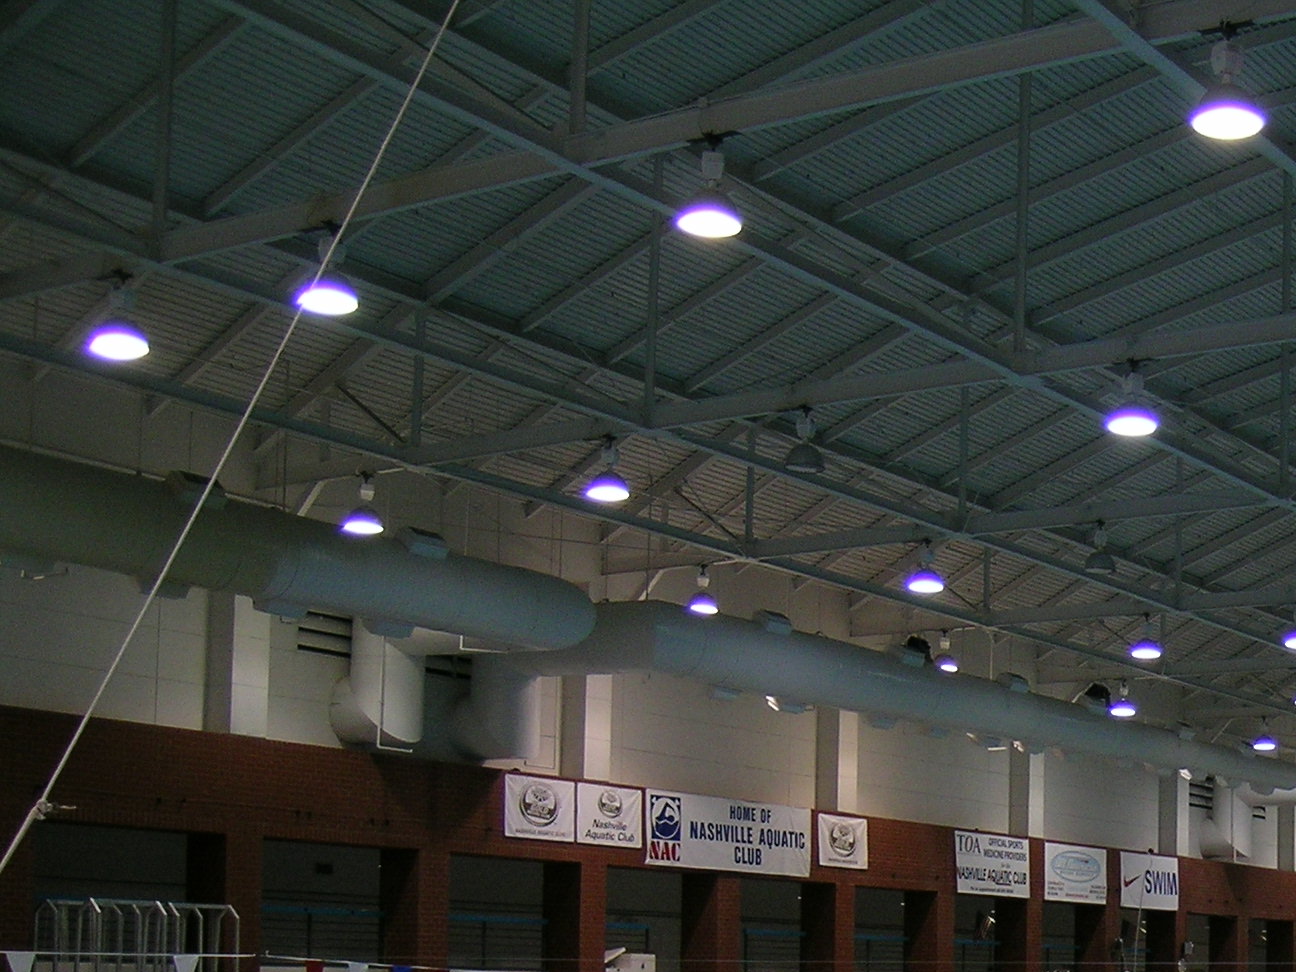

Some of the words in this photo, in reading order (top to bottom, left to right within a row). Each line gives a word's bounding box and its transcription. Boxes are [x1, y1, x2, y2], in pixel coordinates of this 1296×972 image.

[729, 804, 757, 823] HOME
[760, 806, 772, 823] OF
[592, 818, 628, 832] Nashville
[585, 828, 615, 842] Aquatic
[617, 832, 635, 844] Club
[689, 821, 753, 844] NASHVILLE
[758, 829, 806, 850] AQUATIC
[957, 834, 981, 853] TOA
[649, 840, 681, 862] NAC
[734, 847, 762, 866] CLUB
[1013, 871, 1026, 885] CLUB
[1145, 869, 1178, 896] SWIM
